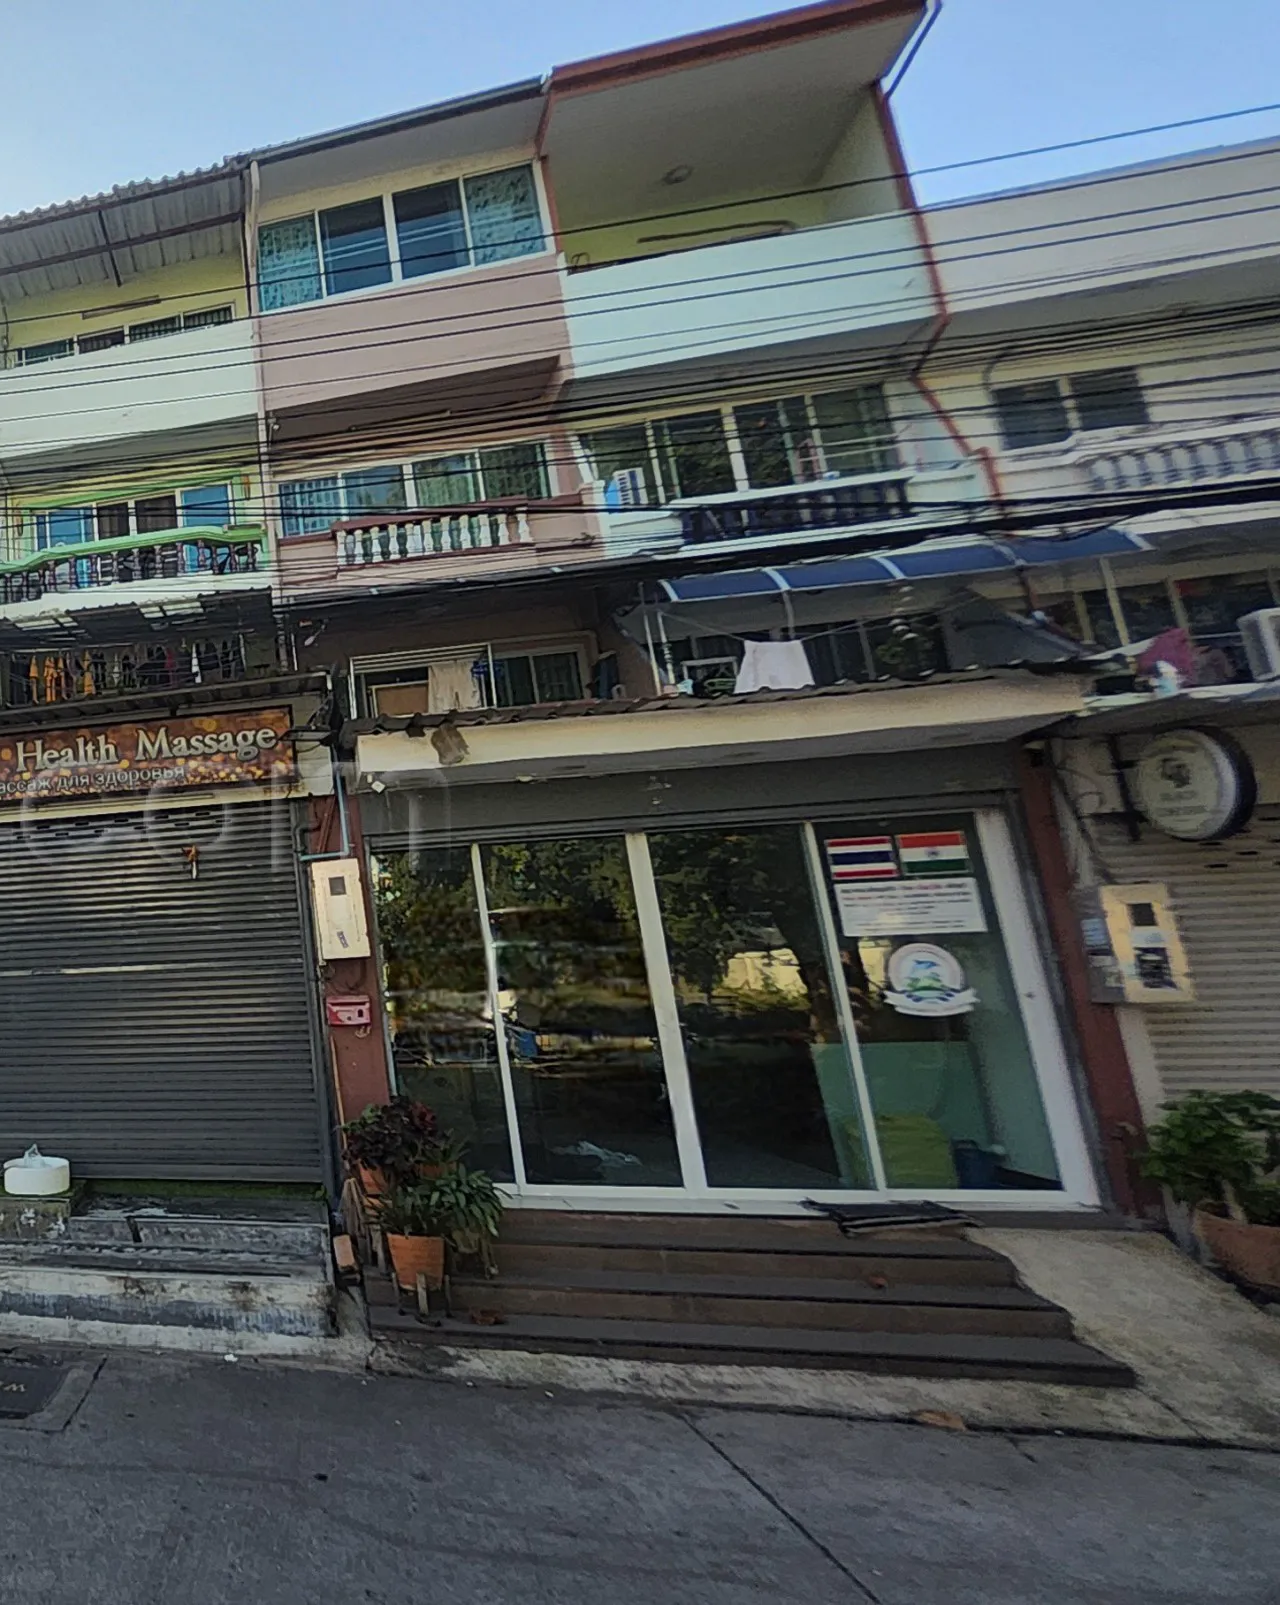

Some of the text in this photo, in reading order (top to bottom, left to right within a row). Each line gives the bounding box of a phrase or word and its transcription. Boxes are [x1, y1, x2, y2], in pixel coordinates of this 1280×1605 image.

[16, 733, 119, 772] Health
[134, 726, 277, 762] Massage
[57, 772, 90, 791] для
[94, 766, 186, 788] здоровья
